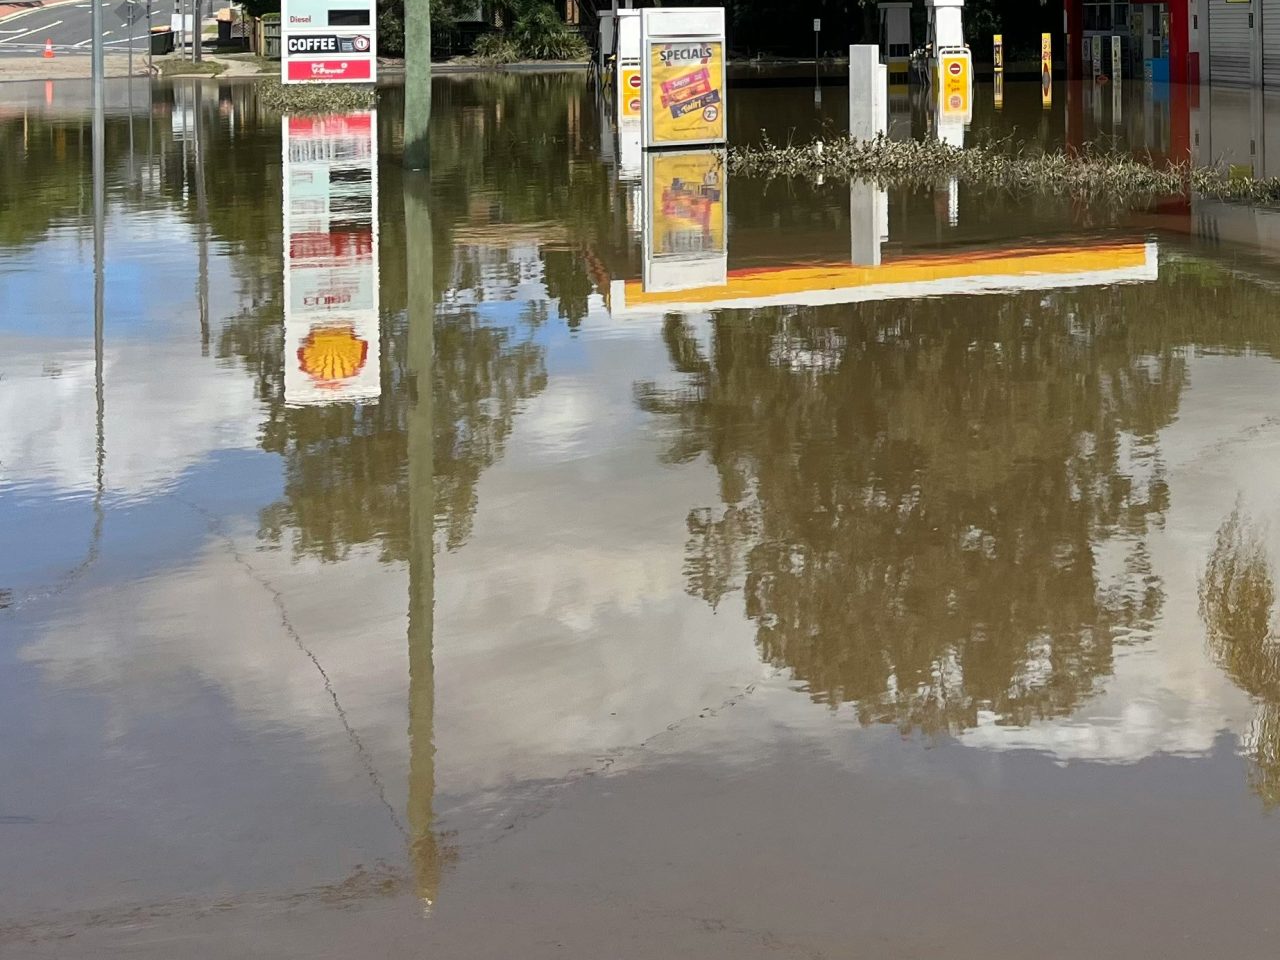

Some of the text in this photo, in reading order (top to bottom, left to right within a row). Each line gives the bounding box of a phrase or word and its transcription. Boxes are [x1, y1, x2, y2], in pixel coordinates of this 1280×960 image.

[289, 15, 312, 23] Diesel
[288, 37, 336, 51] COFFEE
[660, 47, 712, 61] SPECIALS
